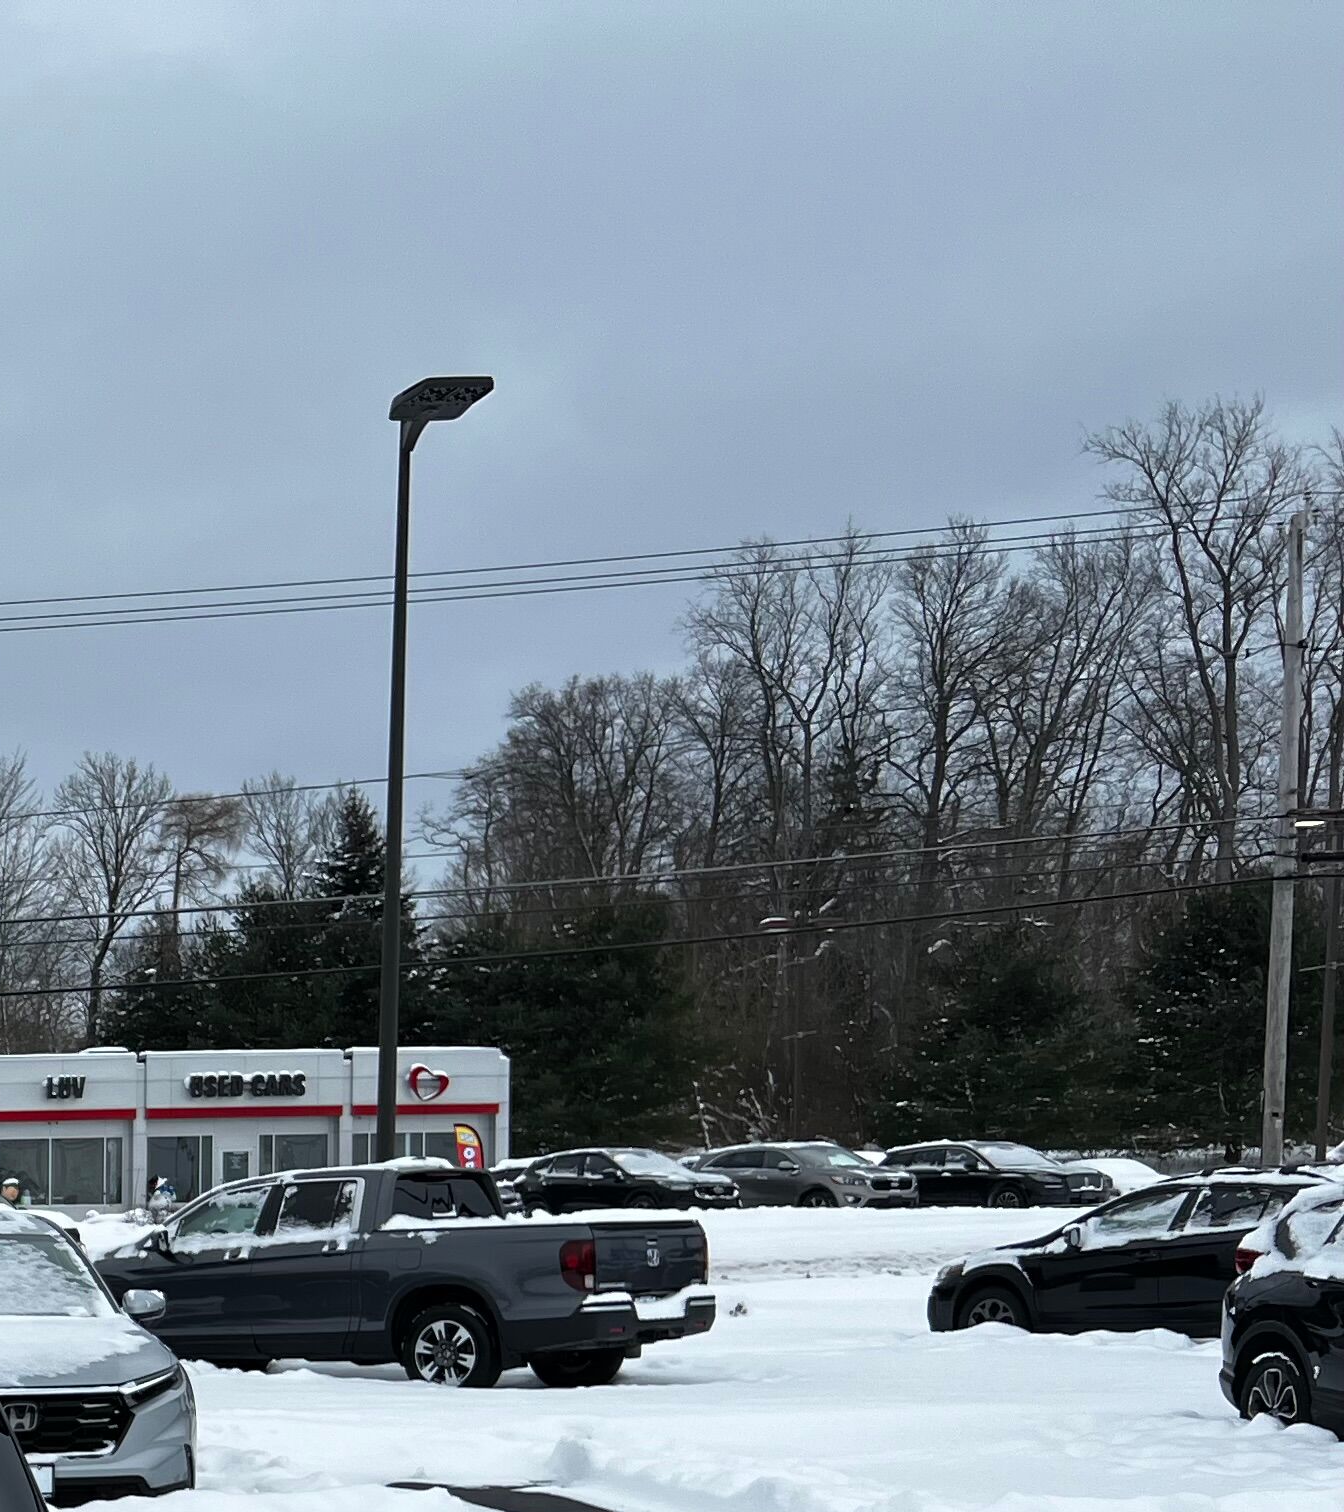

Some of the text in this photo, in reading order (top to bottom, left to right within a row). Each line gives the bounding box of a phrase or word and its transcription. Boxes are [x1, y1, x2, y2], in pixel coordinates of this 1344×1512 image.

[46, 1075, 87, 1099] LUV
[190, 1073, 306, 1098] USED CARS
